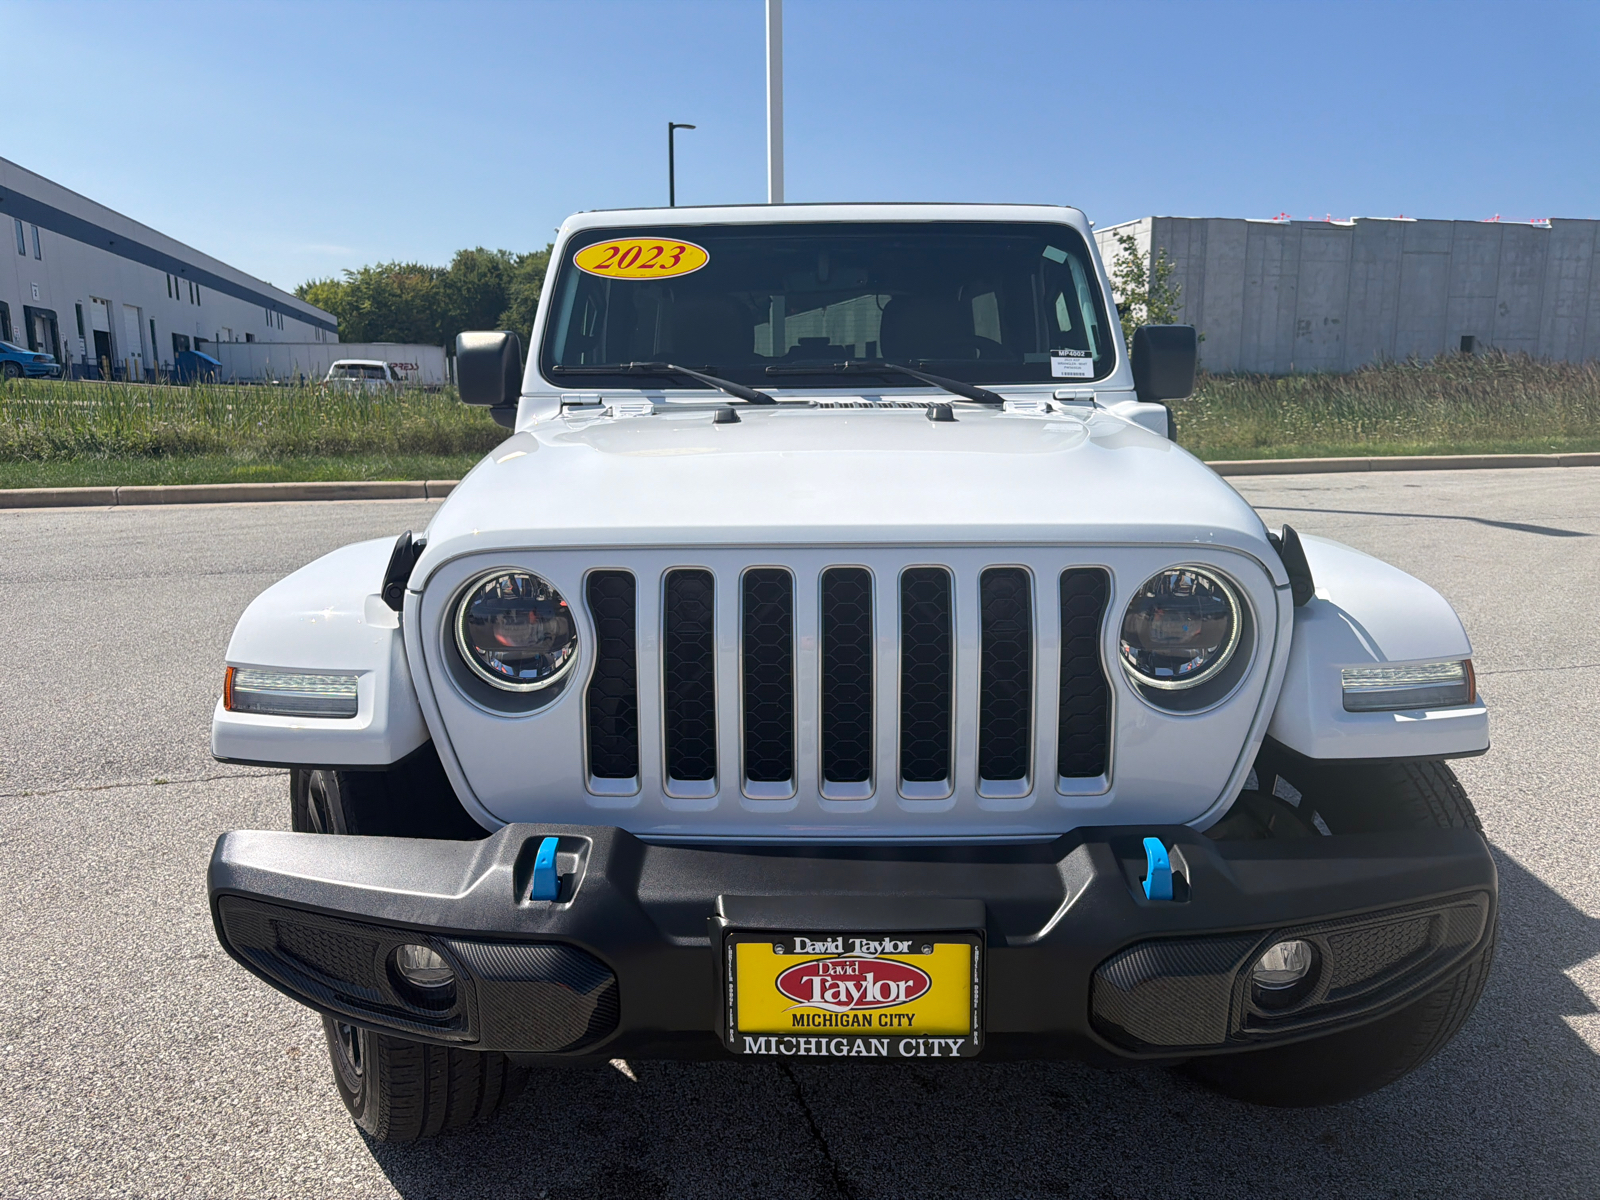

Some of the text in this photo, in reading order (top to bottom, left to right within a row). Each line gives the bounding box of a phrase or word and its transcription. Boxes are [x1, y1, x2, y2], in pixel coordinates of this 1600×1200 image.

[593, 246, 686, 269] 2023
[793, 937, 913, 958] David Taylor
[818, 961, 859, 975] David
[783, 972, 914, 1013] Taylor
[792, 1013, 916, 1027] MICHIGAN CITY
[743, 1037, 965, 1057] MICHIGAN CITY
